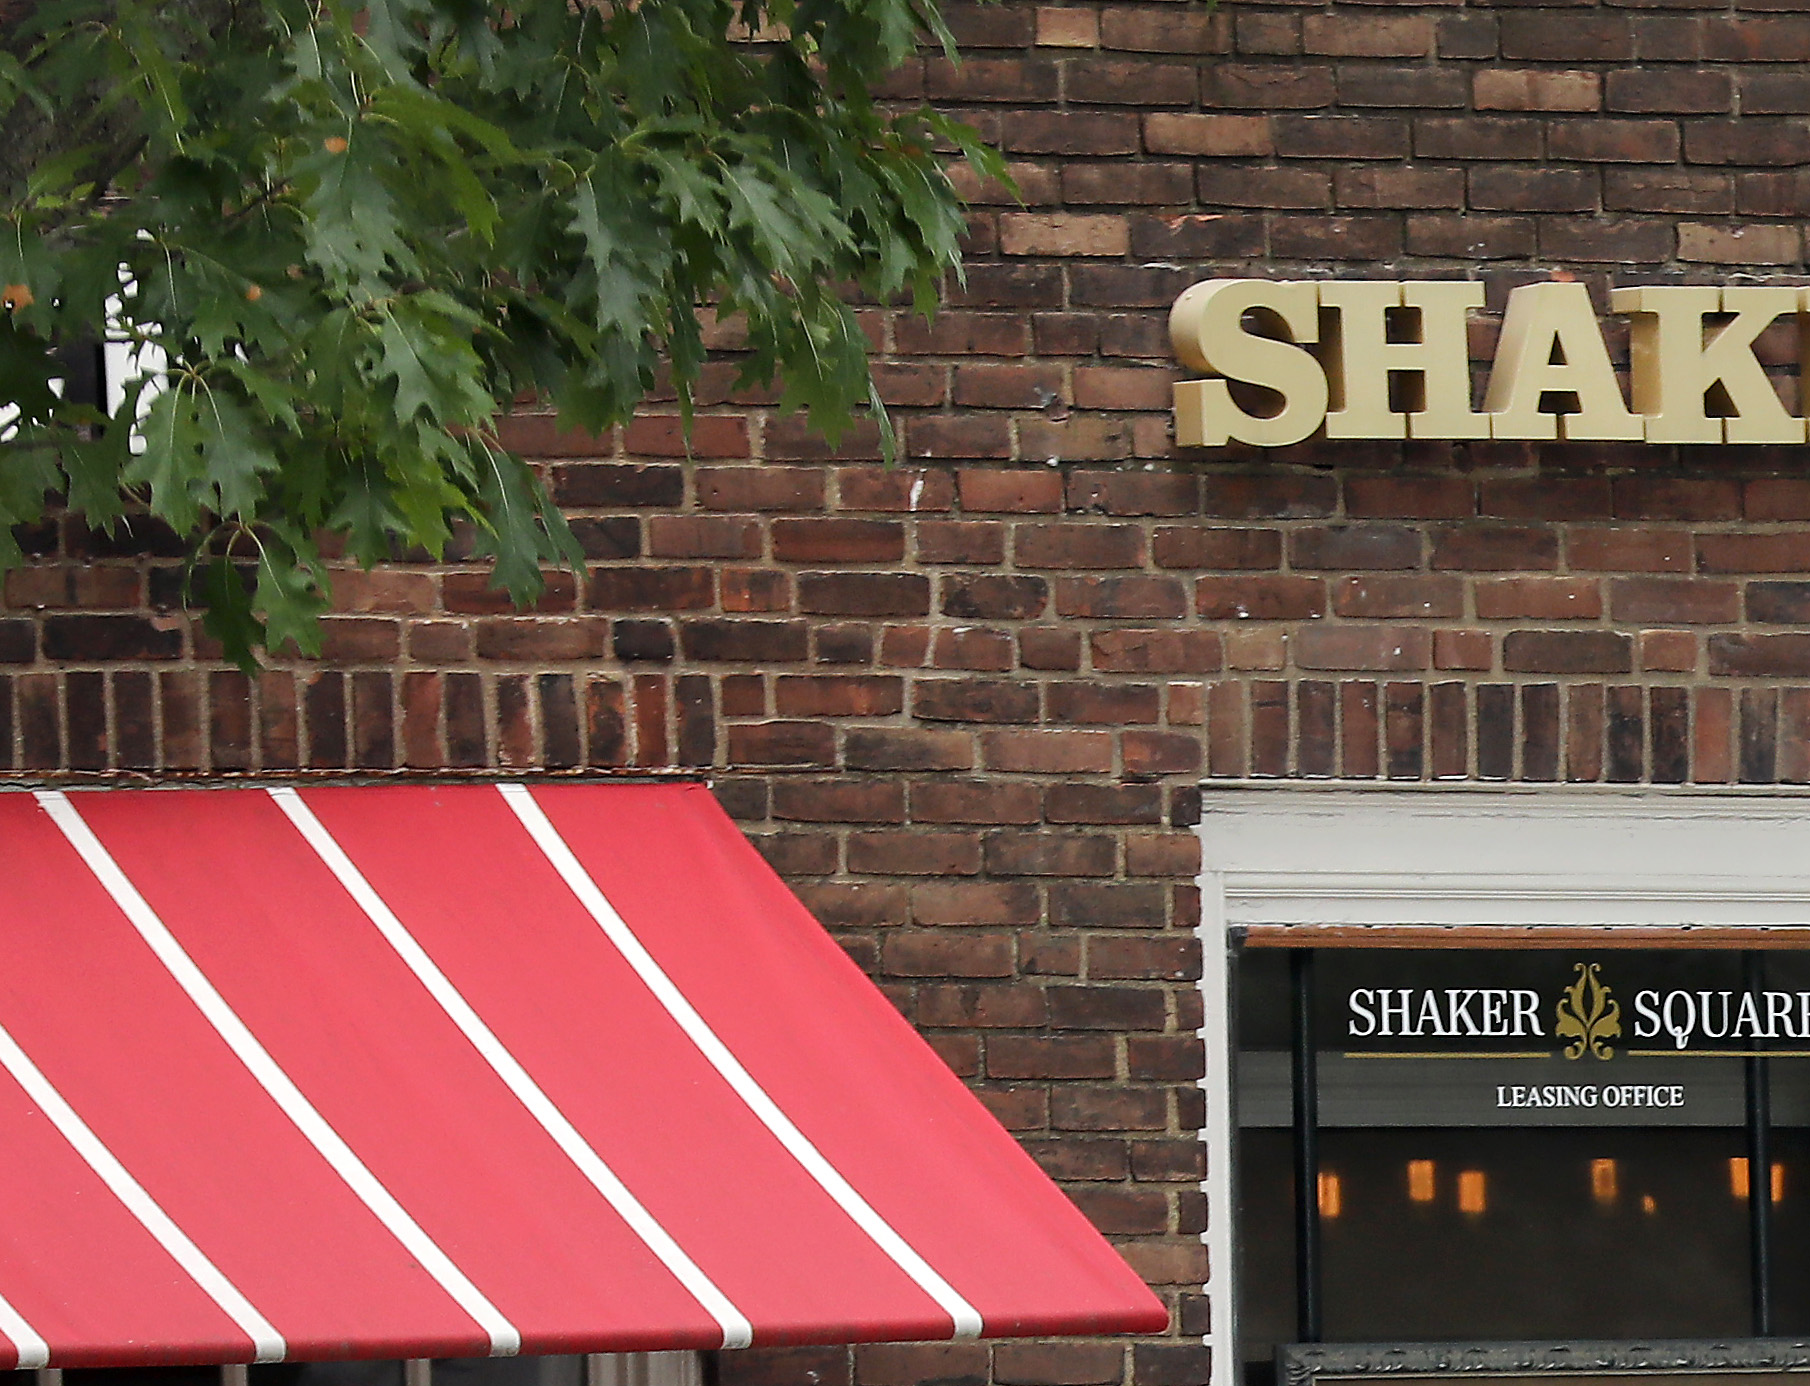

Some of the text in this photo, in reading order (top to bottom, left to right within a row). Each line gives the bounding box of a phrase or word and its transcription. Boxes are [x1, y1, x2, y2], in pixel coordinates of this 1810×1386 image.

[1347, 987, 1544, 1037] SHAKER
[1497, 1084, 1685, 1108] LEASING OFFICE
